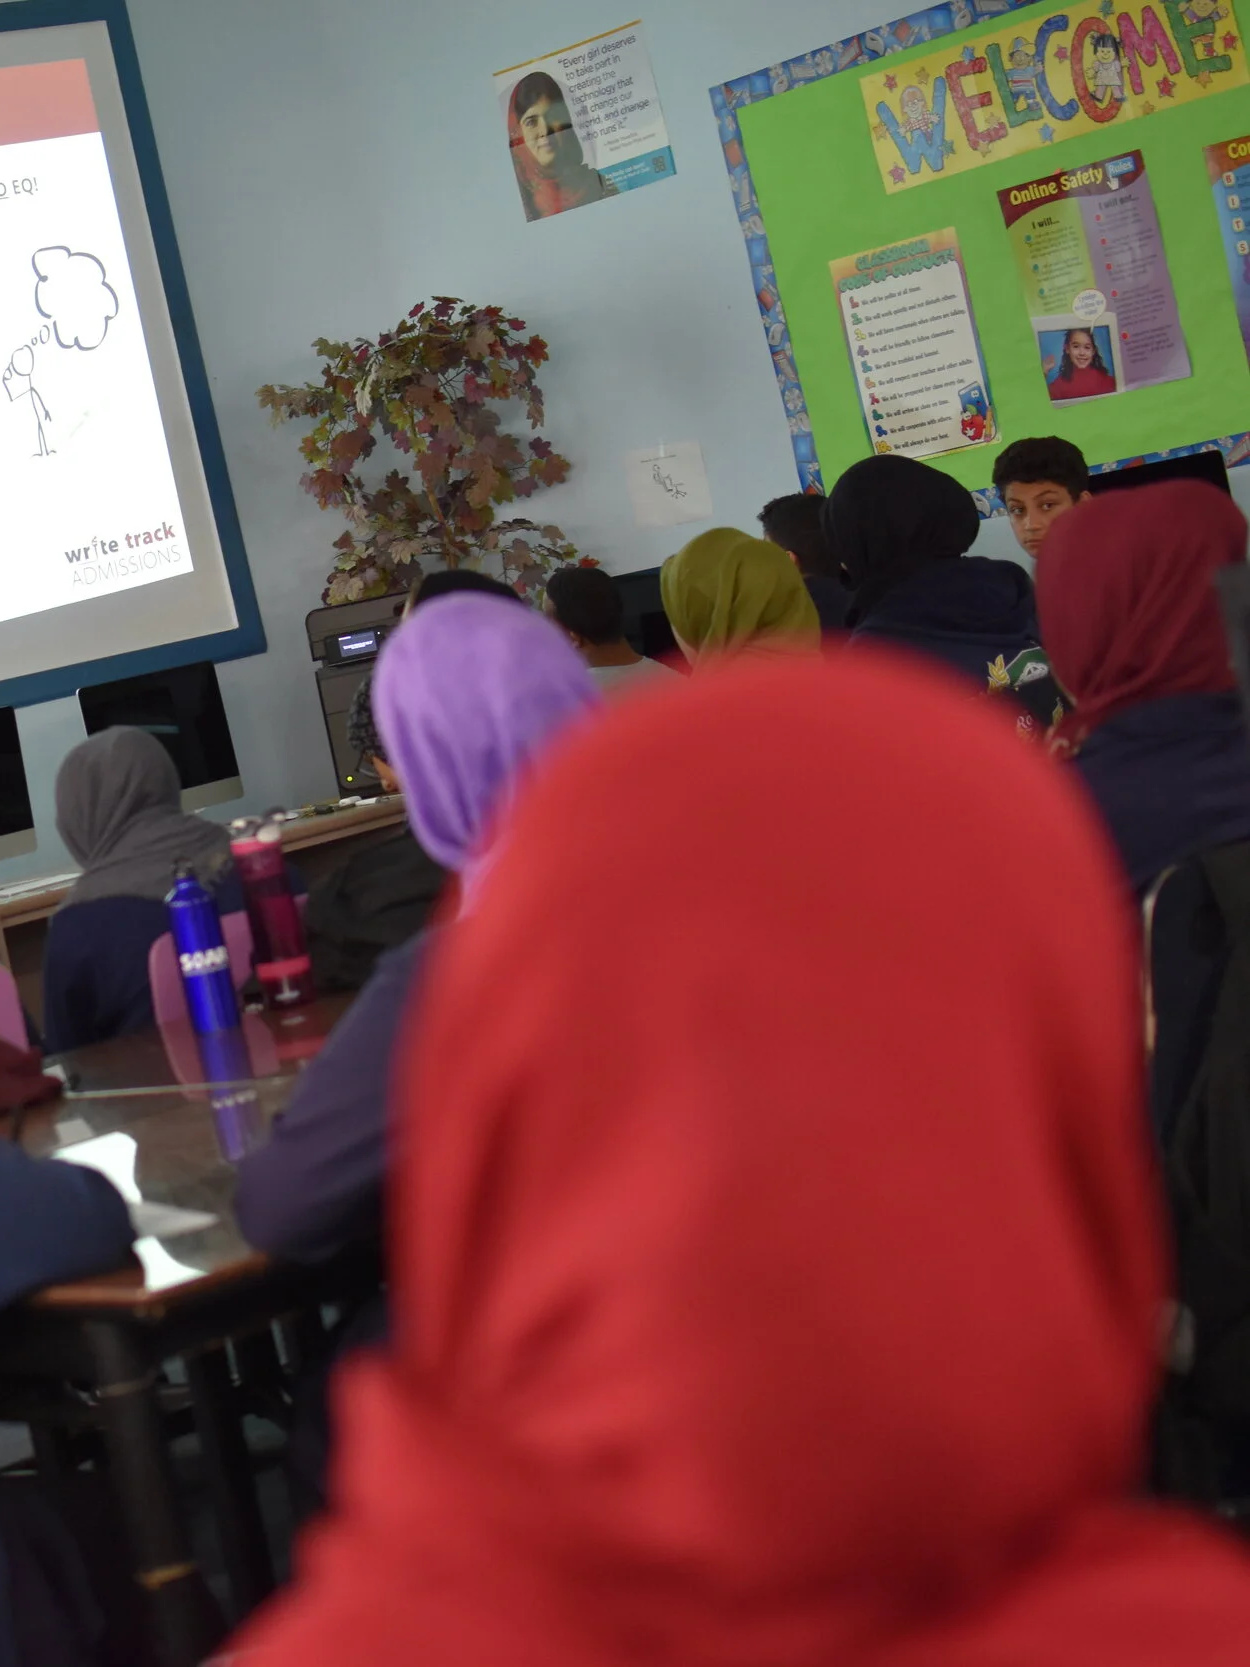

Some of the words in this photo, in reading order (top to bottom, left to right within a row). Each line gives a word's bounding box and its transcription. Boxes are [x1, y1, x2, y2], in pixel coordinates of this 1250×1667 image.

[587, 47, 601, 61] girl
[601, 34, 637, 54] deserves
[565, 70, 575, 80] to
[575, 64, 594, 77] take
[595, 57, 612, 71] part
[613, 54, 621, 66] in
[568, 76, 602, 93] creating
[602, 69, 617, 81] the
[572, 83, 616, 105] technology
[617, 76, 634, 89] that
[875, 0, 1232, 175] WELCOME
[590, 96, 619, 113] change
[604, 109, 619, 121] and
[620, 98, 650, 115] change
[599, 124, 617, 137] runs
[12, 176, 40, 197] EQ!
[1009, 181, 1059, 206] Online
[1059, 167, 1104, 191] Safety
[64, 536, 120, 567] write
[124, 521, 176, 550] track
[71, 544, 182, 588] ADMISSIONS
